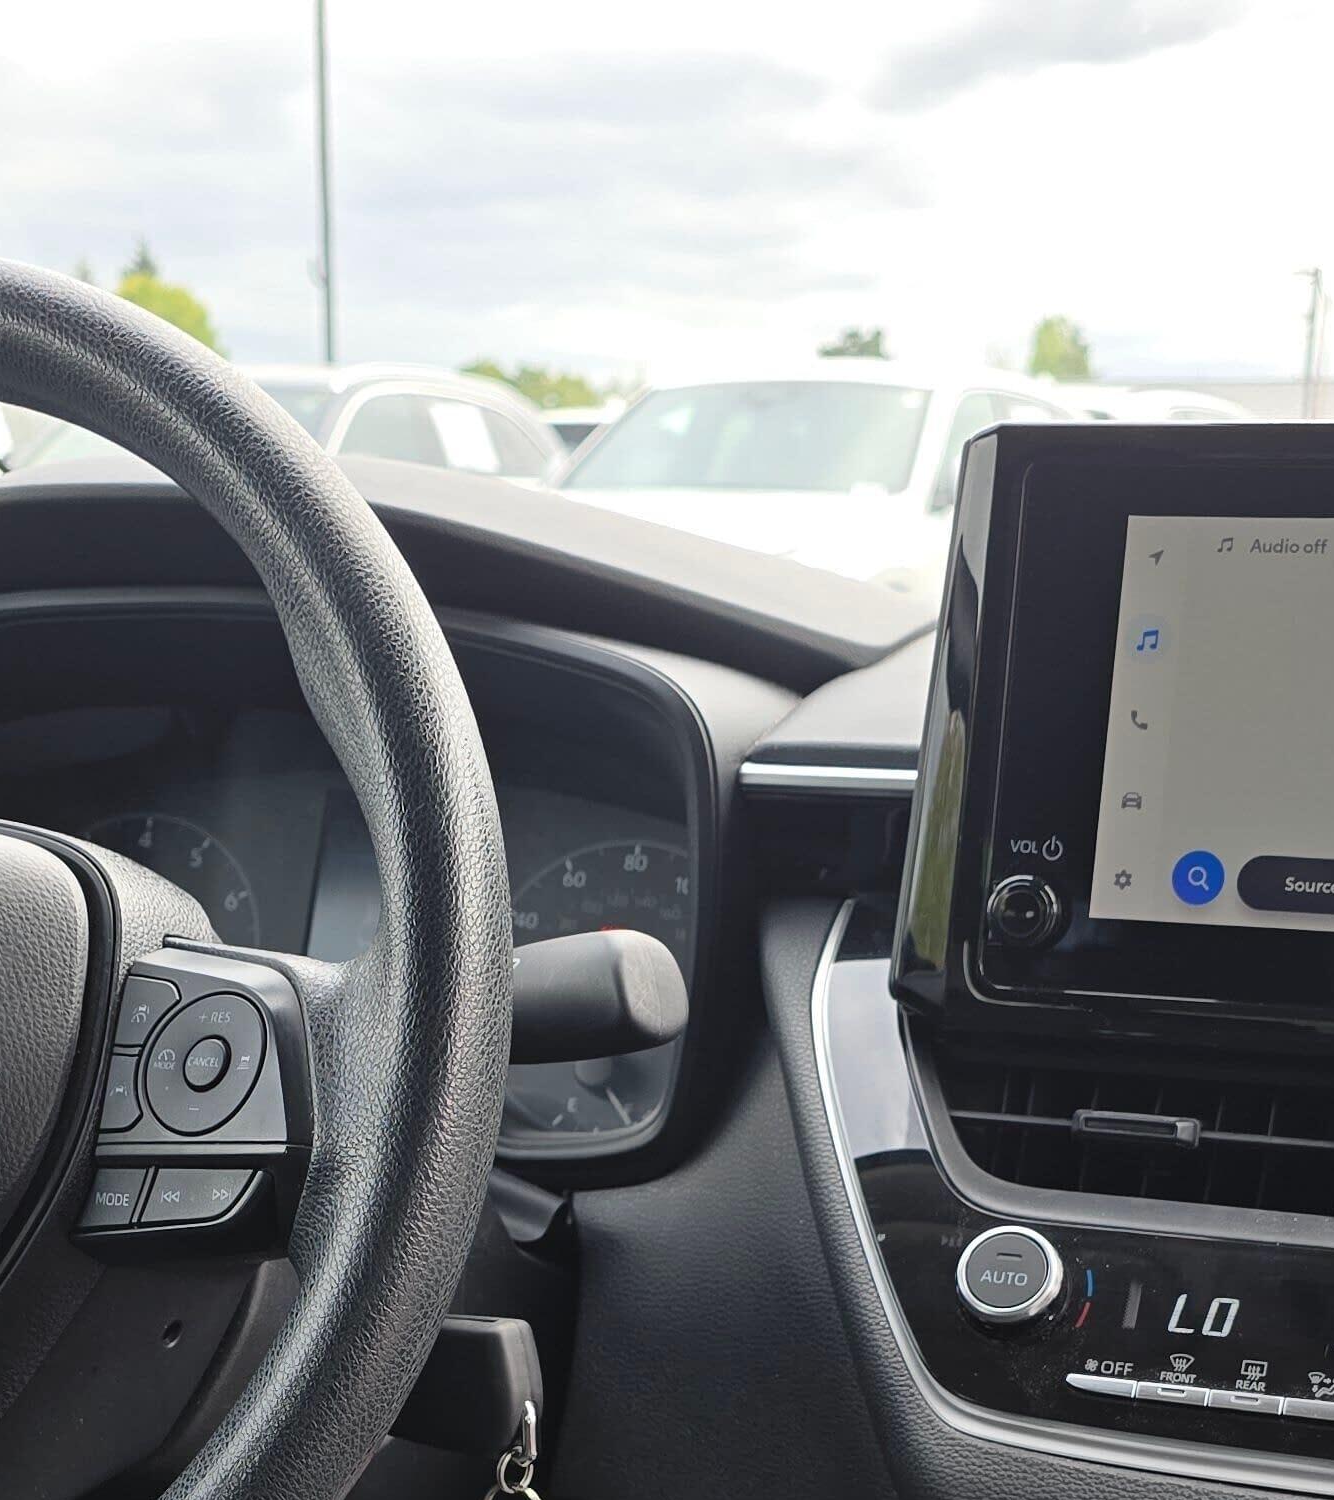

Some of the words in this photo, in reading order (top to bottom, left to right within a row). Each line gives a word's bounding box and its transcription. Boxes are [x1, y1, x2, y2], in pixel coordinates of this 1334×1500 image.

[1249, 538, 1300, 554] Audio
[1303, 538, 1328, 554] off
[1010, 839, 1038, 854] VOL
[562, 870, 587, 888] 60
[224, 891, 238, 911] 6
[211, 1011, 231, 1024] RES
[186, 1055, 219, 1068] CANCEL
[95, 1191, 130, 1207] MODE
[980, 1269, 1028, 1287] AUTO
[1167, 1293, 1240, 1338] LO
[1100, 1360, 1134, 1377] OFF
[1159, 1370, 1197, 1385] FRONT
[1235, 1379, 1266, 1393] REAR
